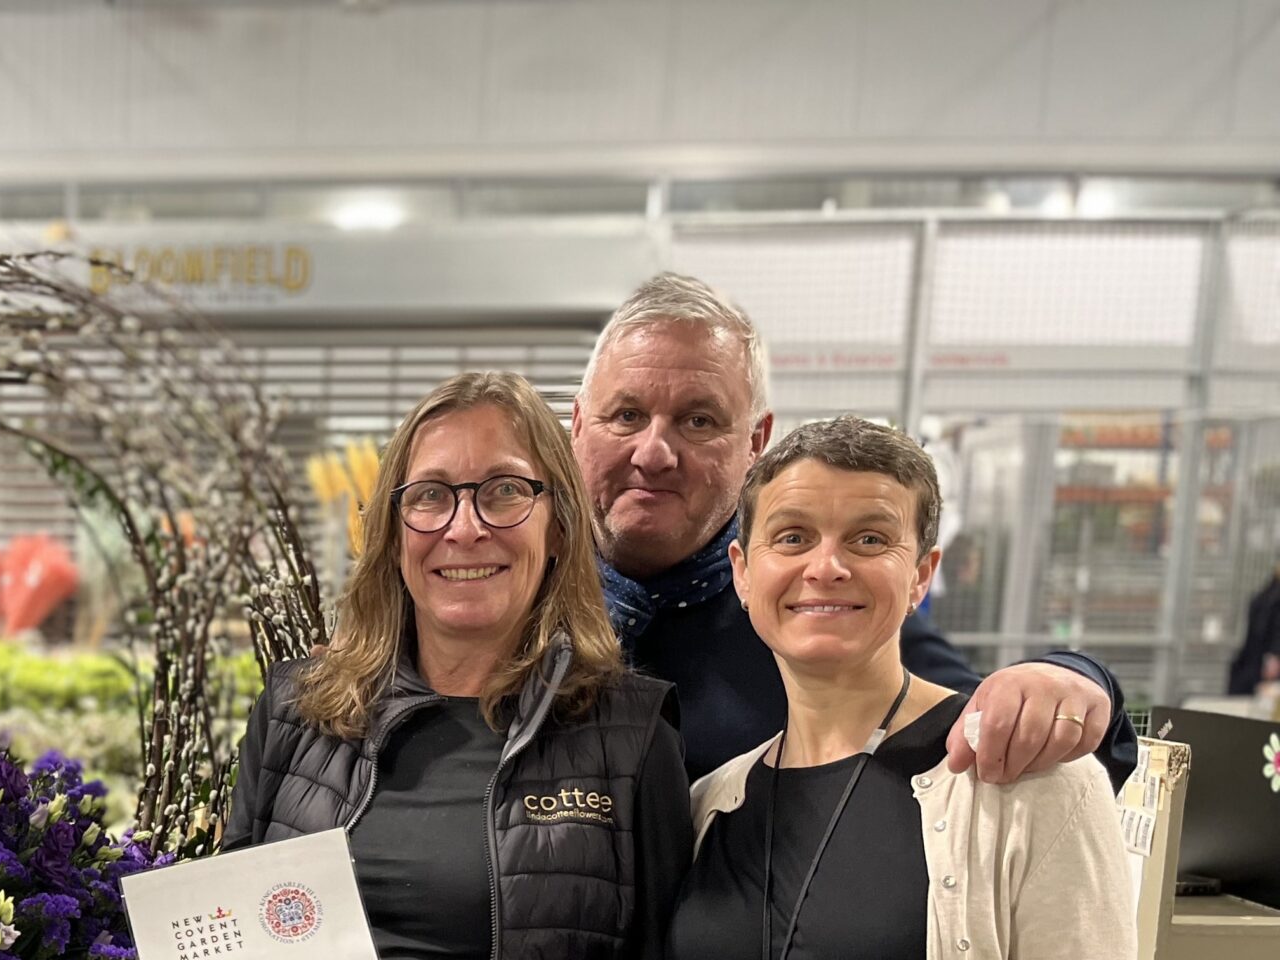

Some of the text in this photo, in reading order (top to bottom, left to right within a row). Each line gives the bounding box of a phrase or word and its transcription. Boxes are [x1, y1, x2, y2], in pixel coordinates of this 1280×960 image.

[523, 787, 613, 813] cottee
[171, 915, 202, 930] NEW
[174, 918, 238, 940] COVENT
[177, 929, 242, 951] GARDEN
